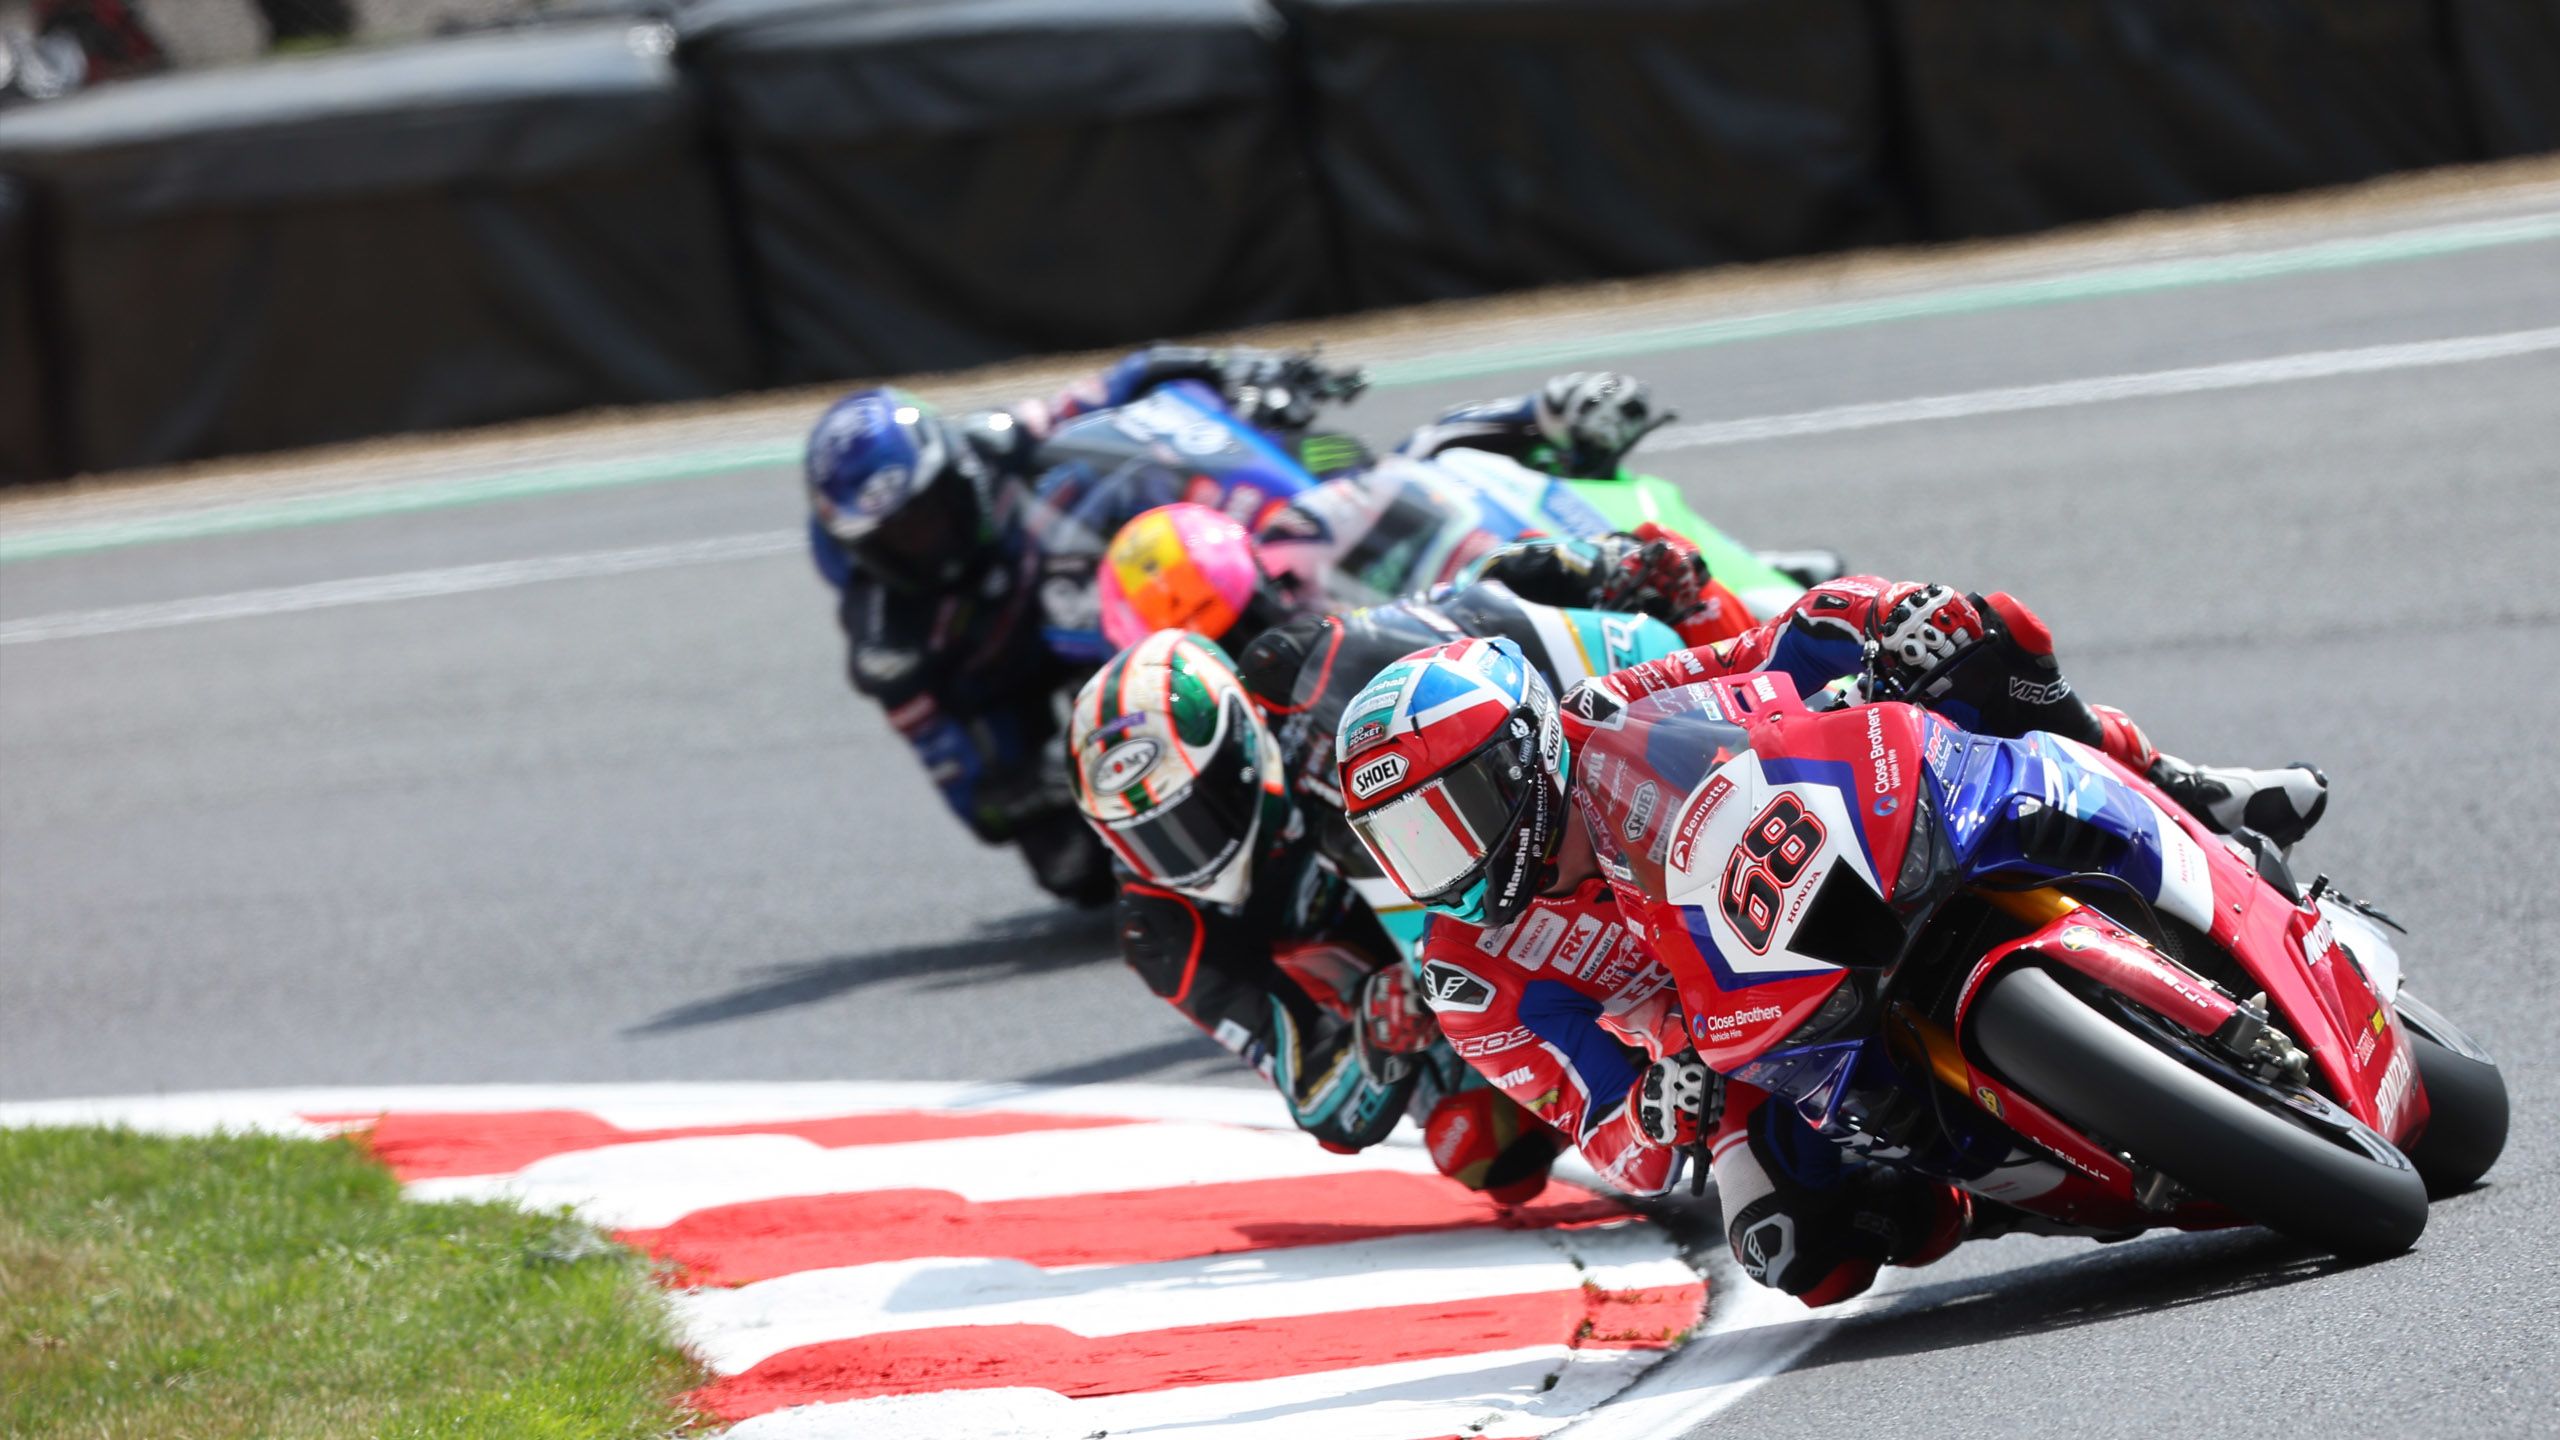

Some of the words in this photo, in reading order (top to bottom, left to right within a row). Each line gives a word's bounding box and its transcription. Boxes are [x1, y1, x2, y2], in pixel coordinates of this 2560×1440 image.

[1548, 719, 1561, 766] SHOEI
[1867, 707, 1885, 759] Brothers
[1356, 759, 1400, 792] SHOEI
[1874, 758, 1889, 794] Close
[1889, 764, 1901, 789] Vehicle
[1534, 773, 1545, 841] PREMIUM
[1627, 788, 1654, 835] SHOEI
[1683, 781, 1728, 838] Bennetts
[1504, 828, 1530, 897] Marshall
[1719, 791, 1827, 955] 68
[1786, 870, 1822, 925] HONDA
[1518, 917, 1549, 959] HONDA
[1559, 925, 1590, 962] RK
[1582, 938, 1612, 980] Marshall
[1625, 952, 1644, 970] BA
[1707, 1015, 1735, 1031] Close
[1736, 1005, 1782, 1026] Brothers
[1710, 1032, 1730, 1043] Vehicle
[1730, 1029, 1742, 1038] Hire
[2375, 1047, 2411, 1133] HONDA
[2032, 1136, 2110, 1182] PIRELLI
